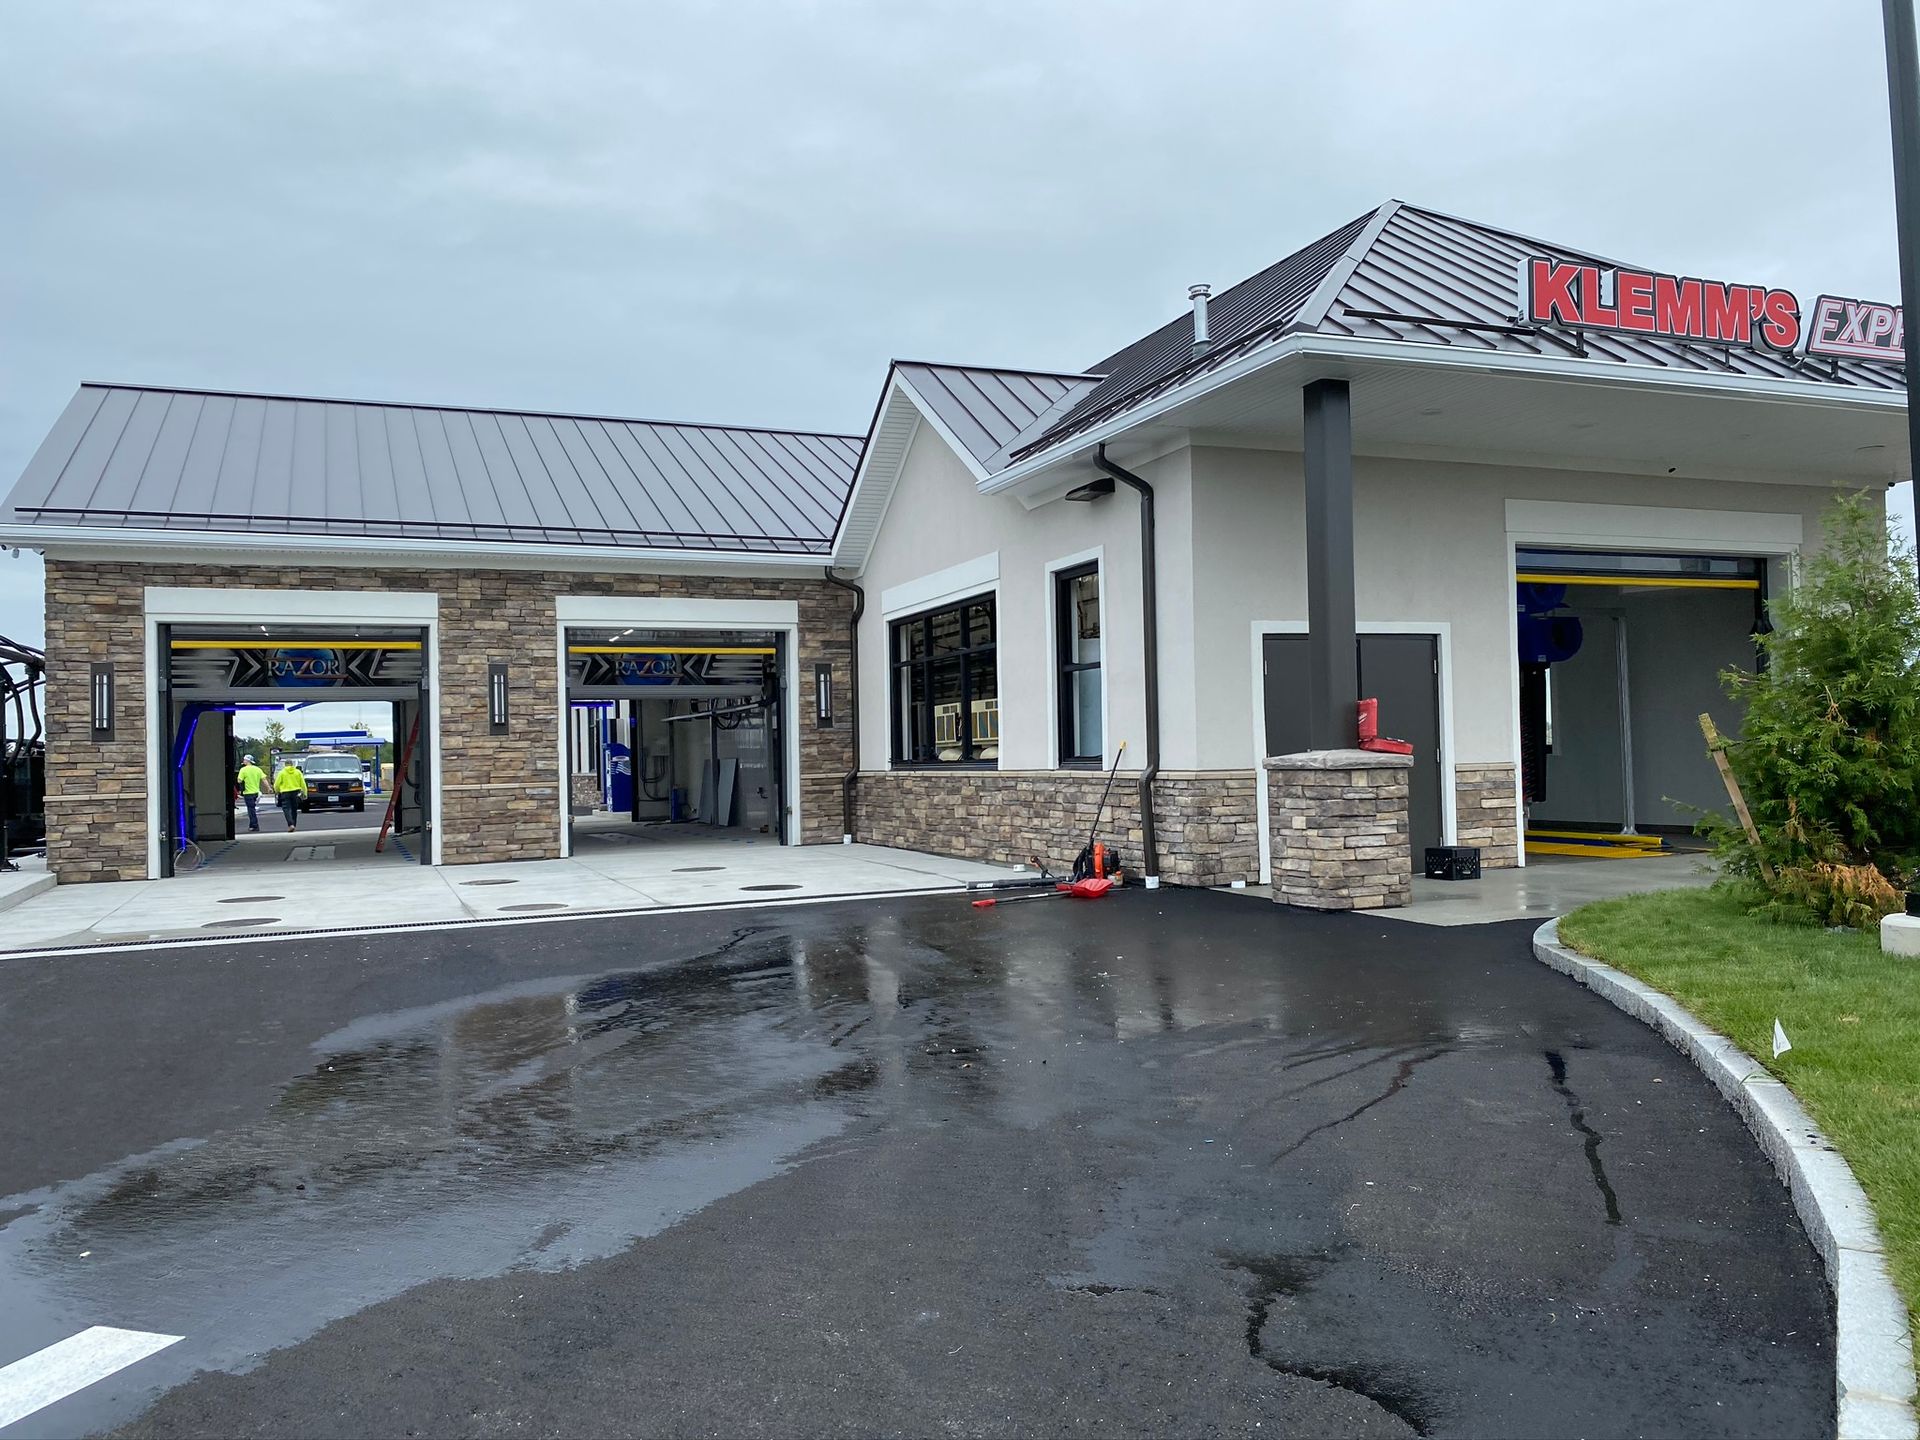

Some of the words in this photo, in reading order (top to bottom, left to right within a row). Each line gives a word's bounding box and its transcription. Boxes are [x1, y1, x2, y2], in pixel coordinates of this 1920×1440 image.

[1532, 259, 1799, 350] KLEMM'S
[265, 657, 349, 679] RAZOR
[613, 658, 684, 677] RAZOR
